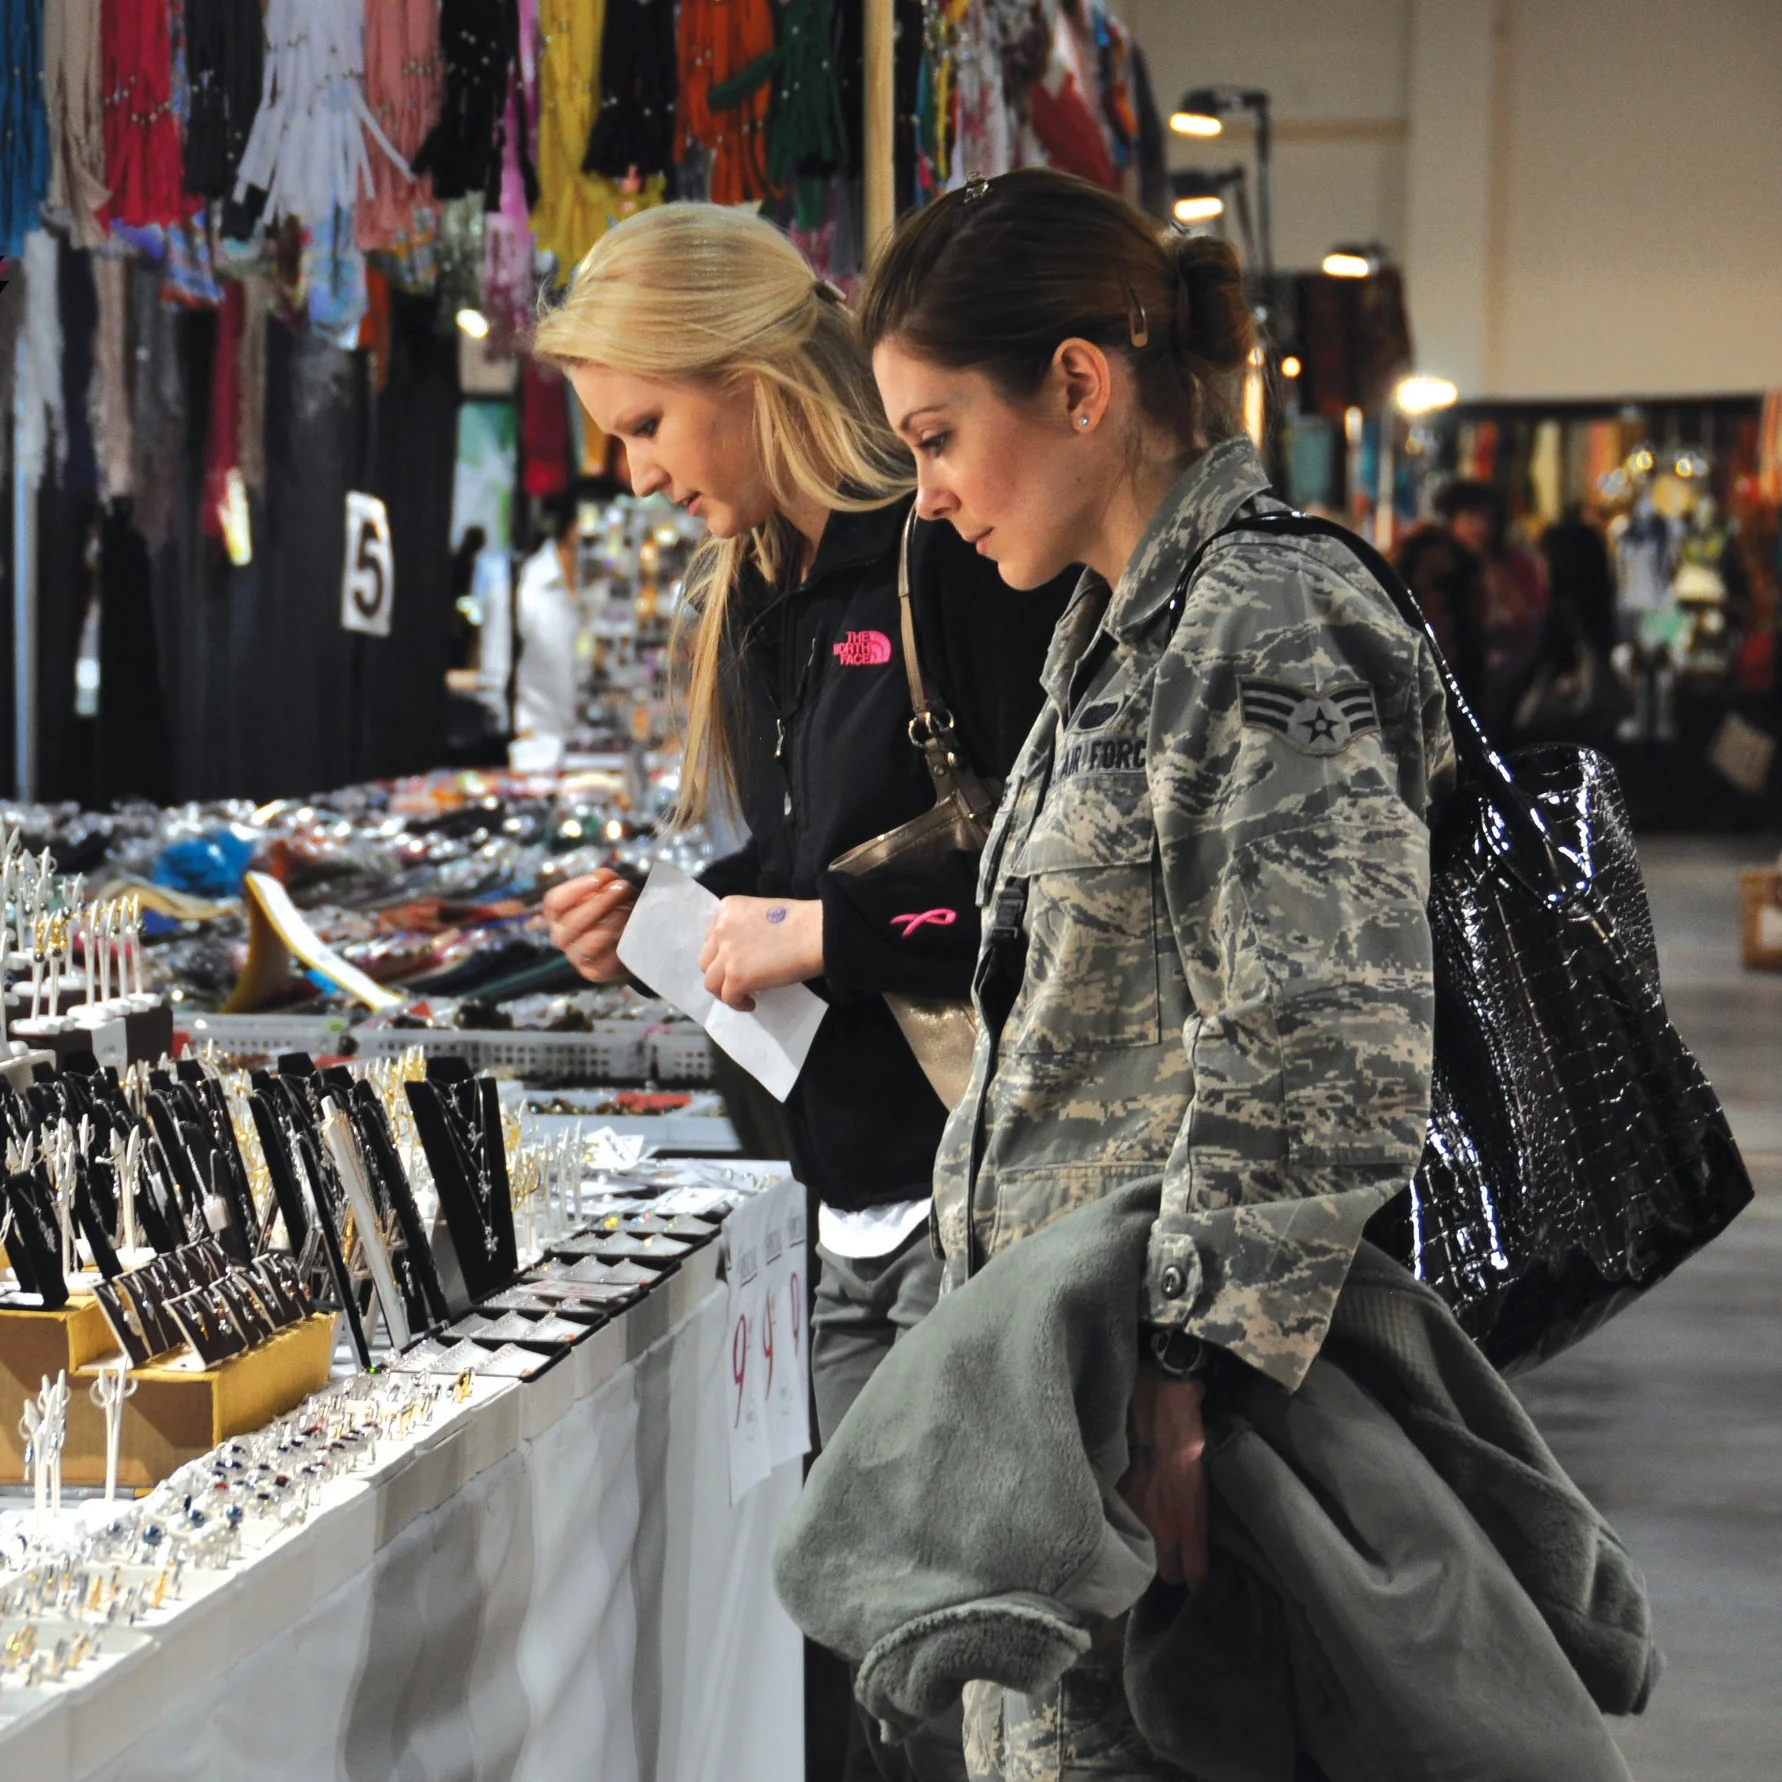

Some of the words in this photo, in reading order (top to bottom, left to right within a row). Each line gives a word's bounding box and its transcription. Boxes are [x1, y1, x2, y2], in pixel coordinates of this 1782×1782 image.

[354, 520, 384, 619] 5
[846, 631, 870, 643] THE
[833, 642, 870, 655] NORTH
[840, 653, 871, 666] FACE
[1089, 739, 1146, 770] FORC
